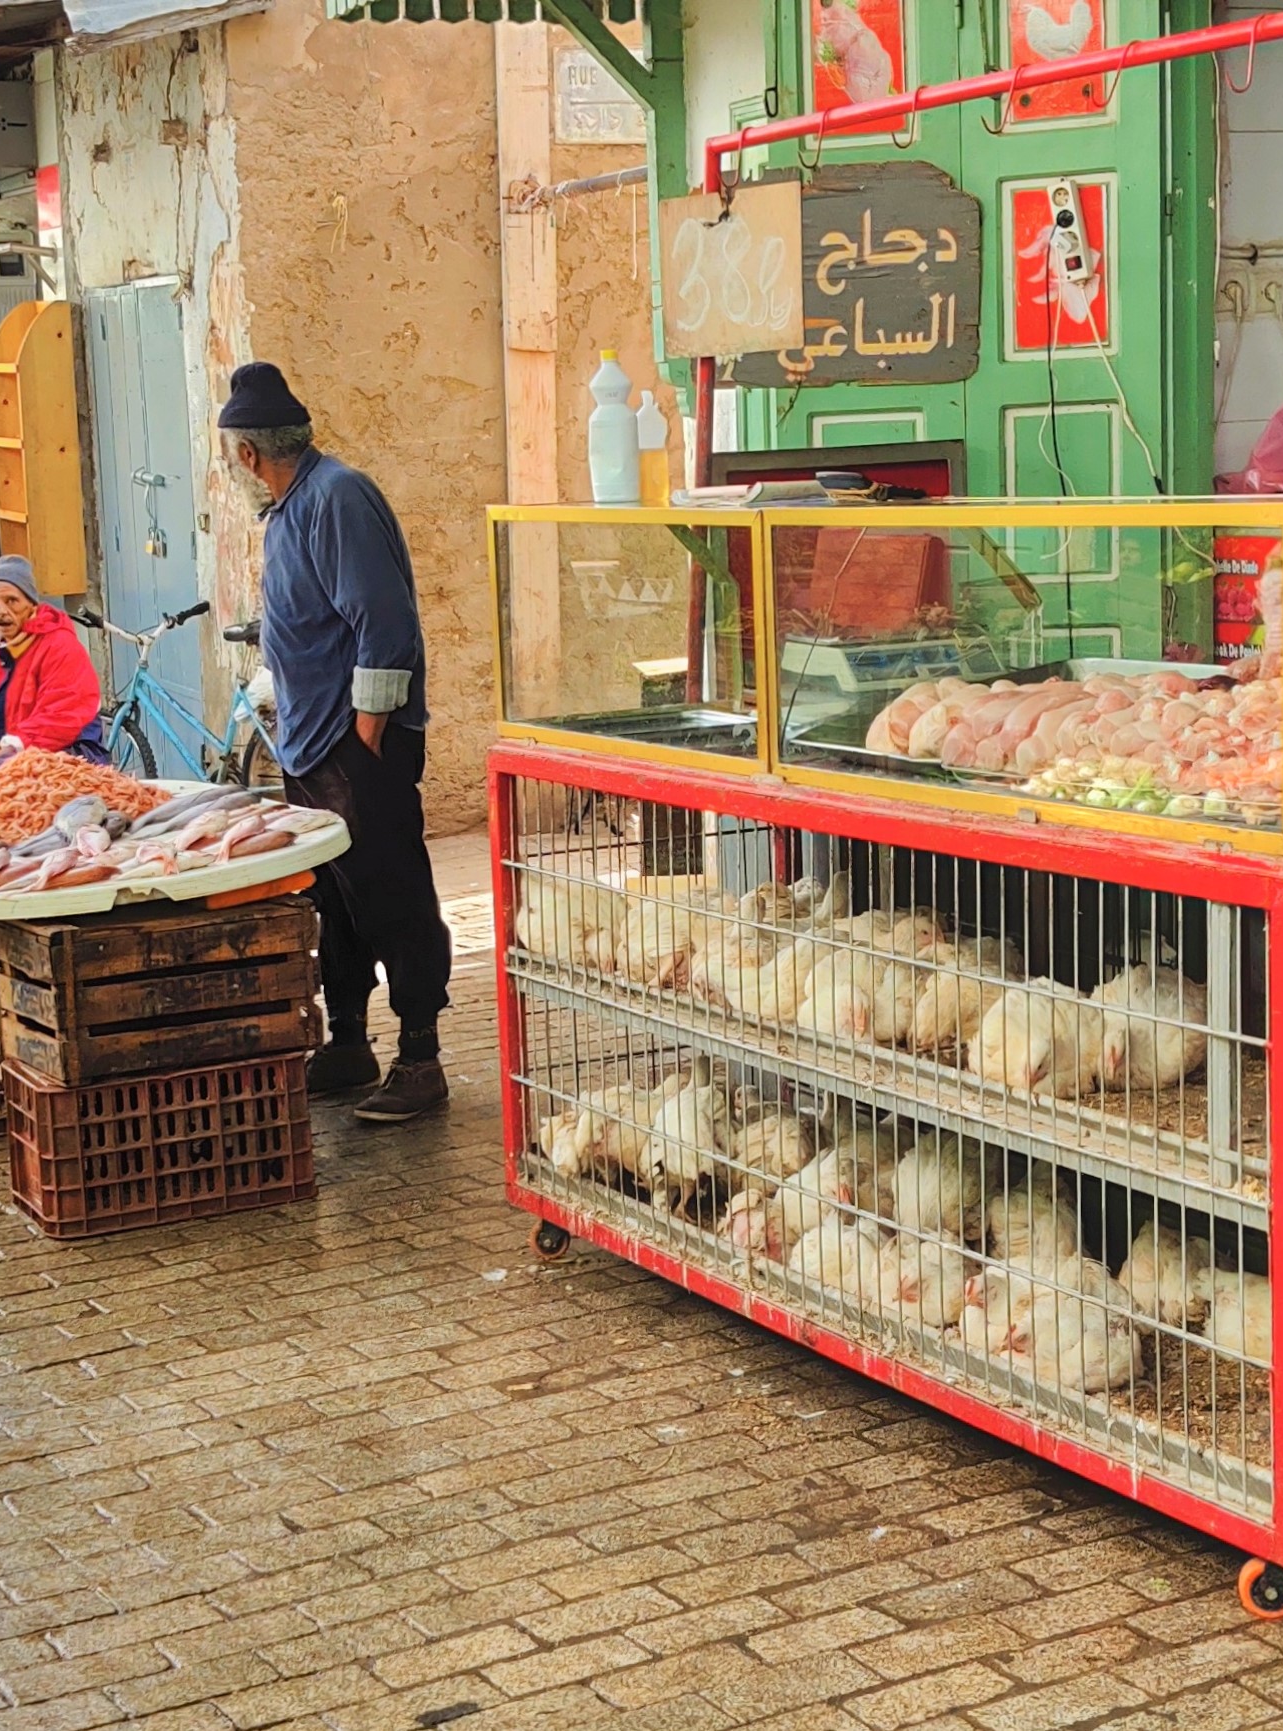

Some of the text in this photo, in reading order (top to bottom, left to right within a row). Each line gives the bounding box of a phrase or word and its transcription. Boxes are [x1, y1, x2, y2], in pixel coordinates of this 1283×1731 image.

[568, 65, 598, 86] RUE
[816, 208, 957, 295] دجاج
[777, 292, 956, 382] السباعي
